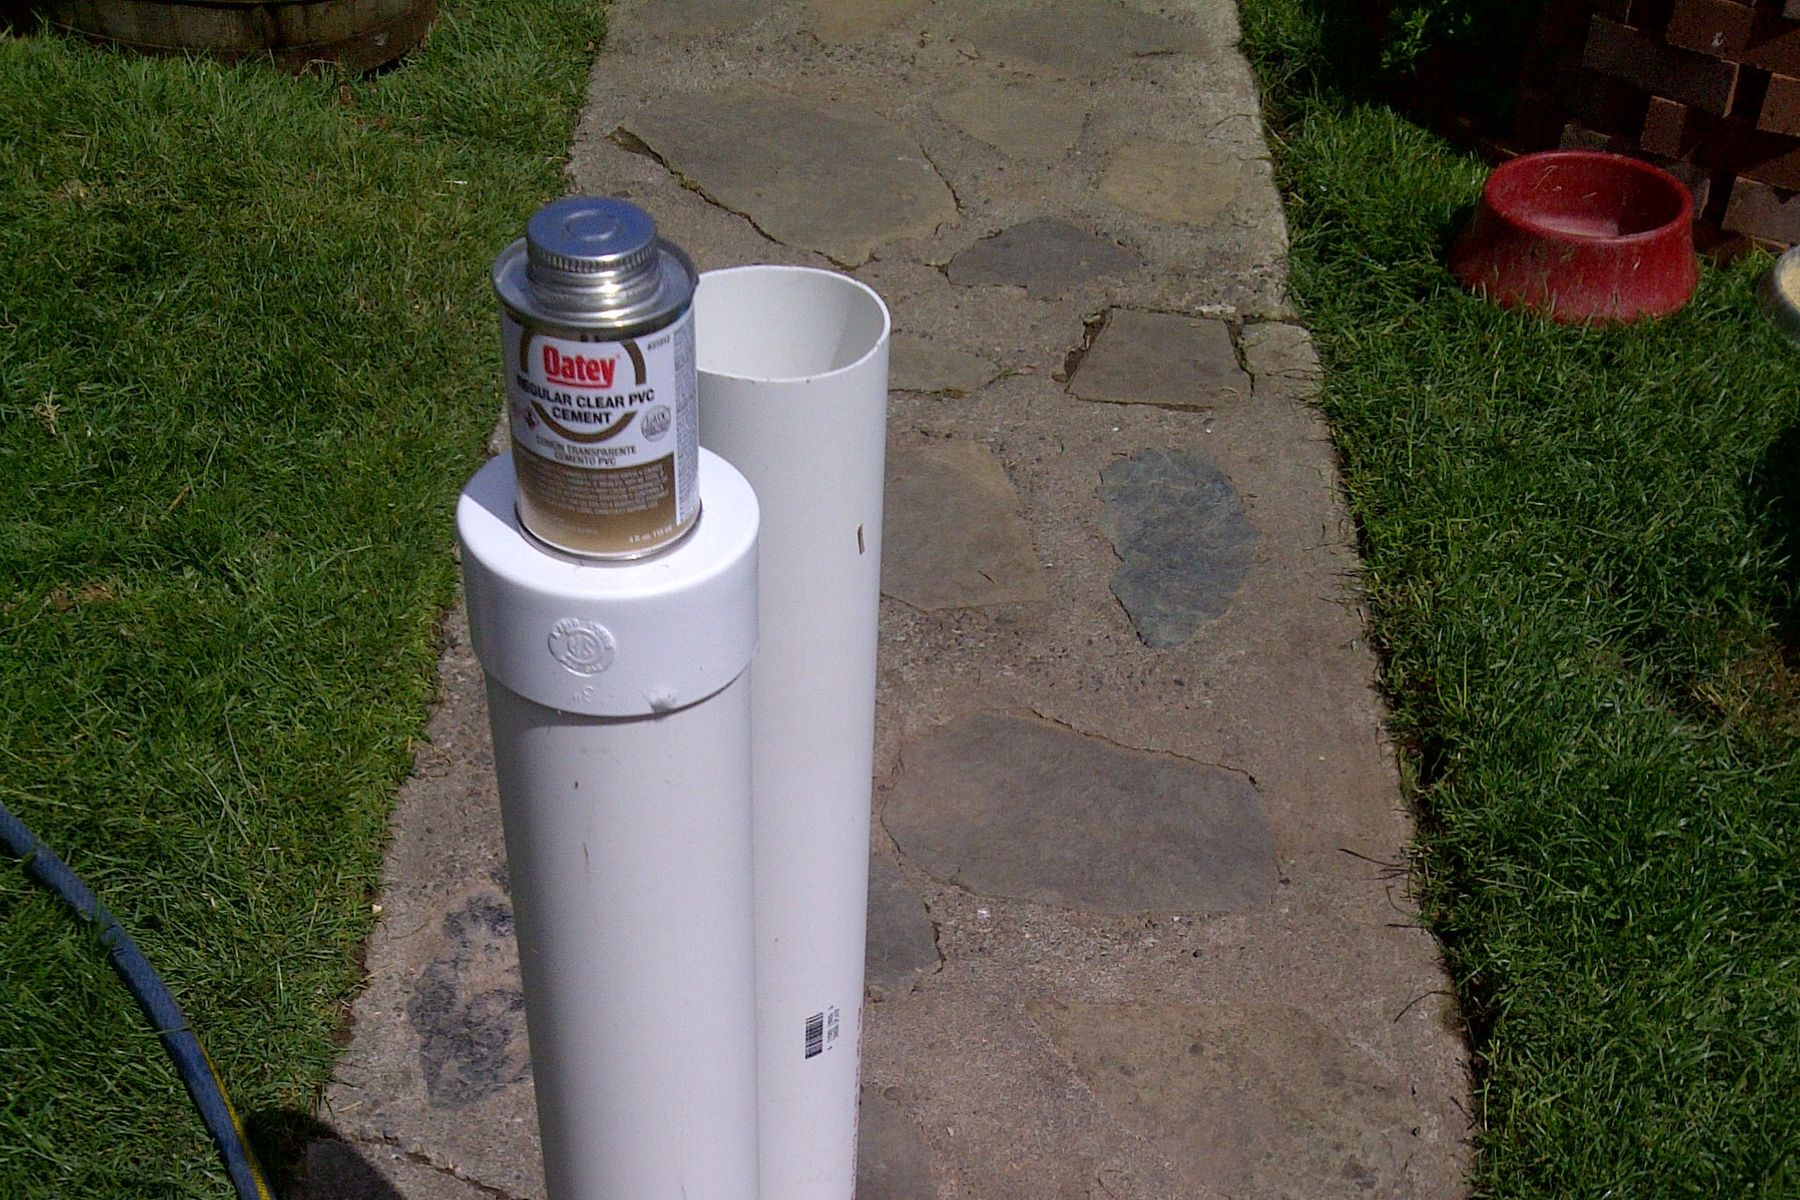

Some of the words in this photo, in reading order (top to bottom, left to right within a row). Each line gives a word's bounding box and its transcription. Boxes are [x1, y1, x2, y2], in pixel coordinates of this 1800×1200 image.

[543, 345, 616, 388] Oatey
[576, 395, 625, 409] CLEAR
[628, 388, 655, 406] PVC
[552, 407, 611, 424] CEMENT
